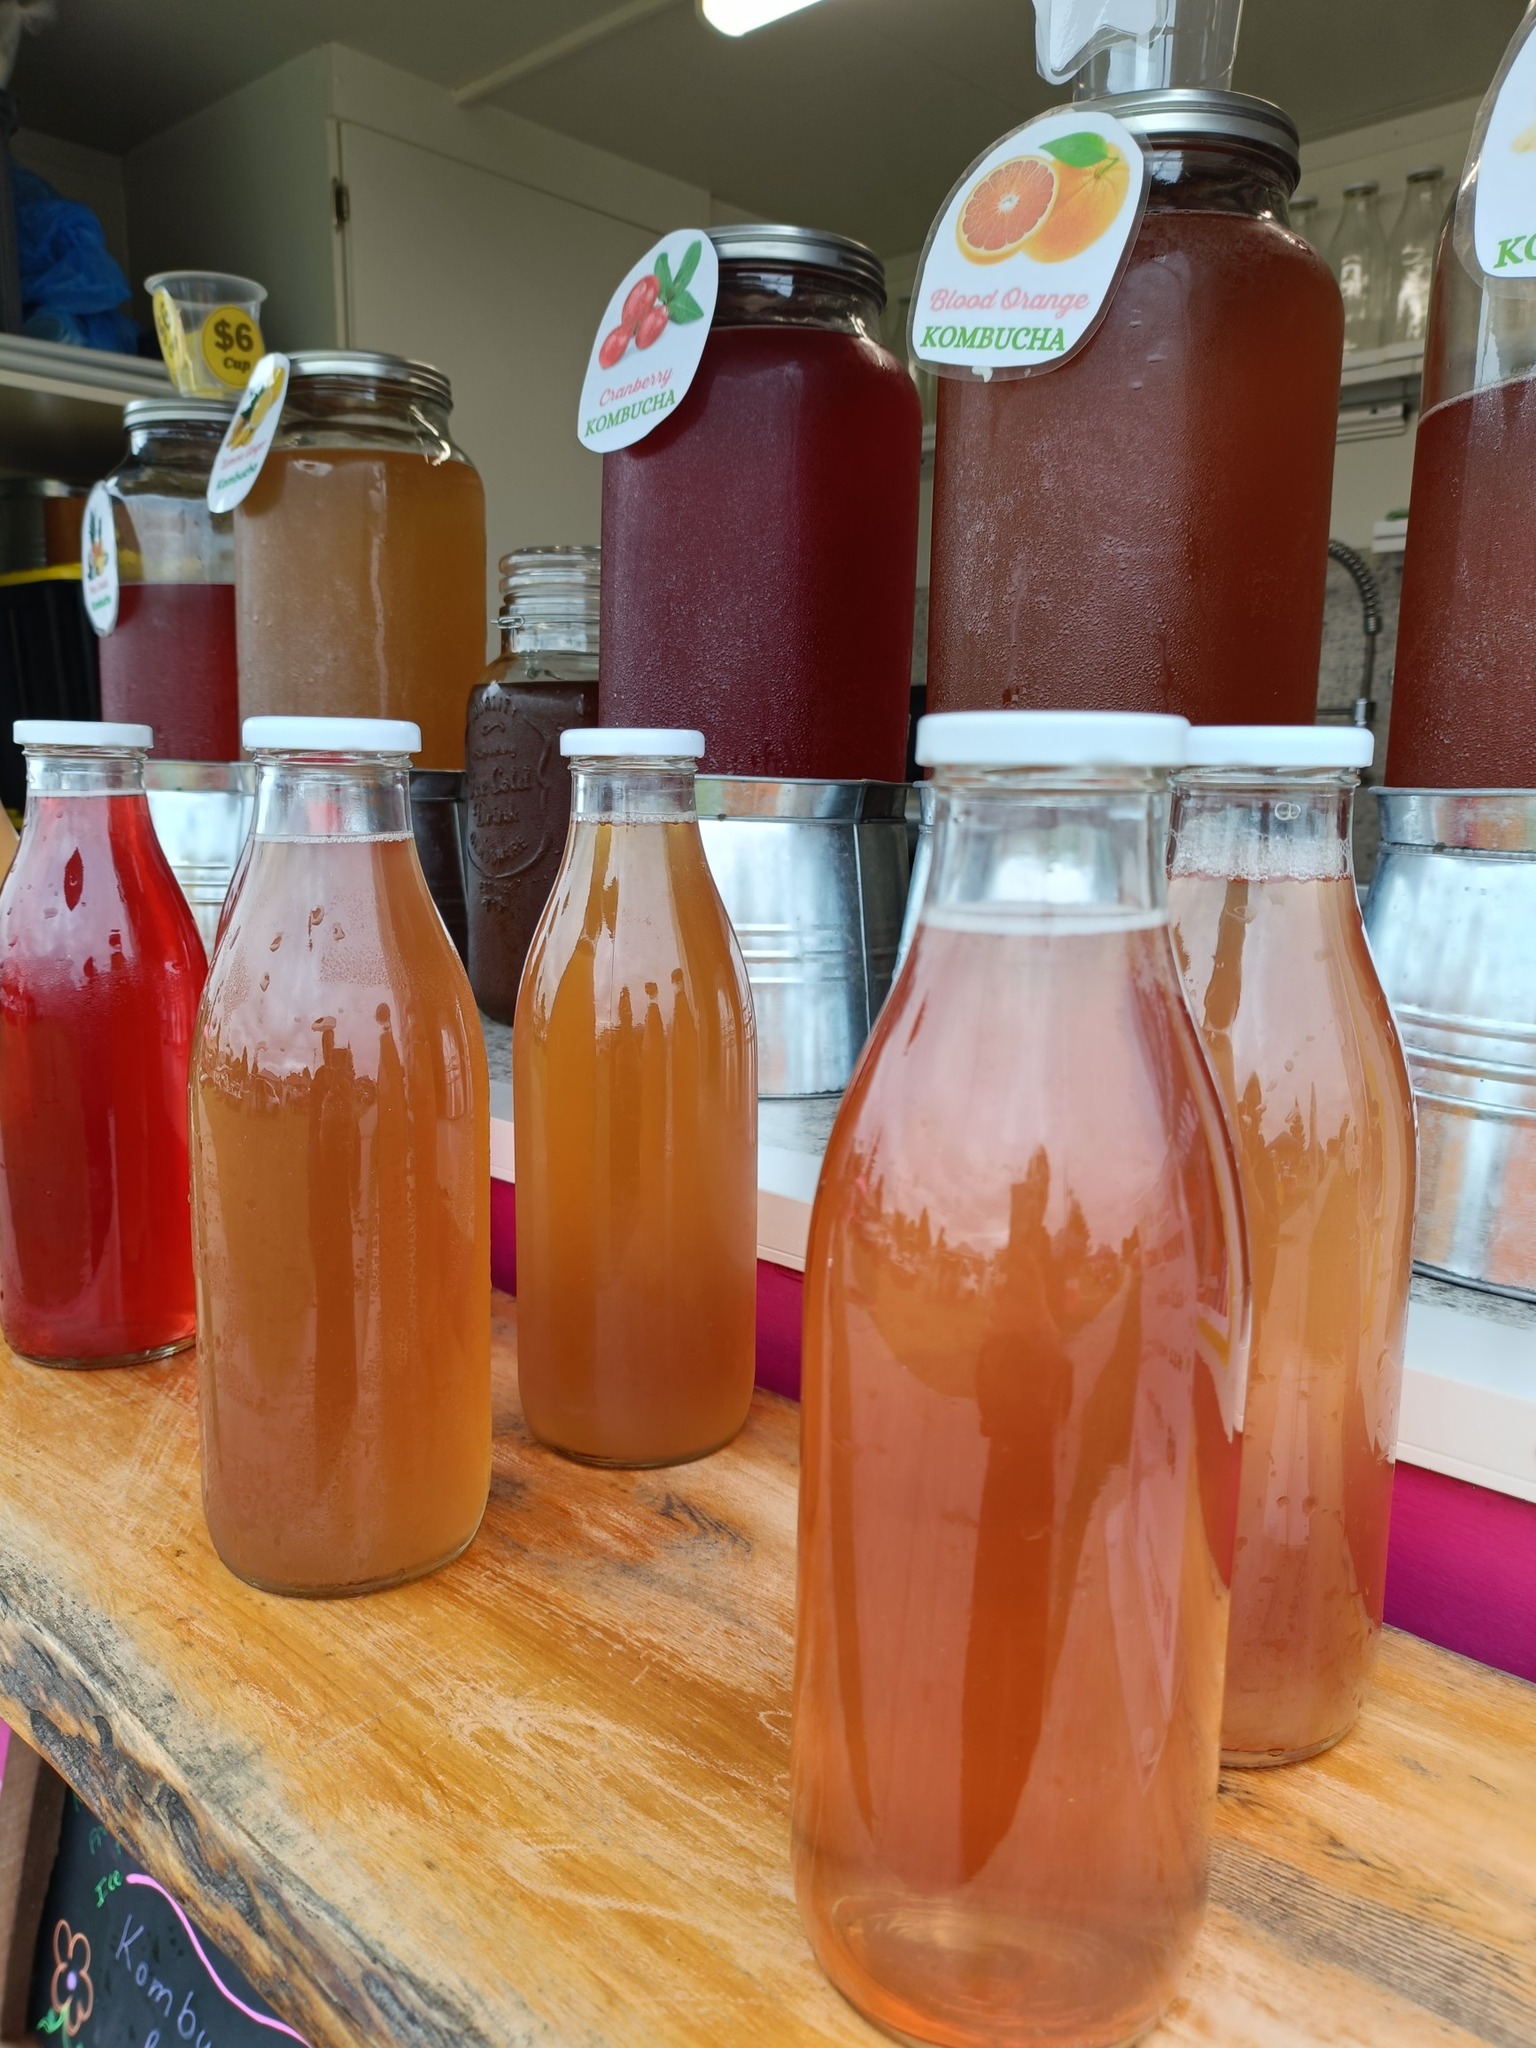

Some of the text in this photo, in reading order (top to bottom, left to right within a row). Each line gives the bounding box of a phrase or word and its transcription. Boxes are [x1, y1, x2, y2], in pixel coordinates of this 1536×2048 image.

[930, 287, 1090, 320] Blood Orange
[213, 319, 254, 353] $6
[919, 326, 1065, 351] KOMBUCHA
[223, 357, 251, 374] Cup
[599, 368, 673, 407] Cranberry
[584, 389, 676, 437] KOMBUCHA
